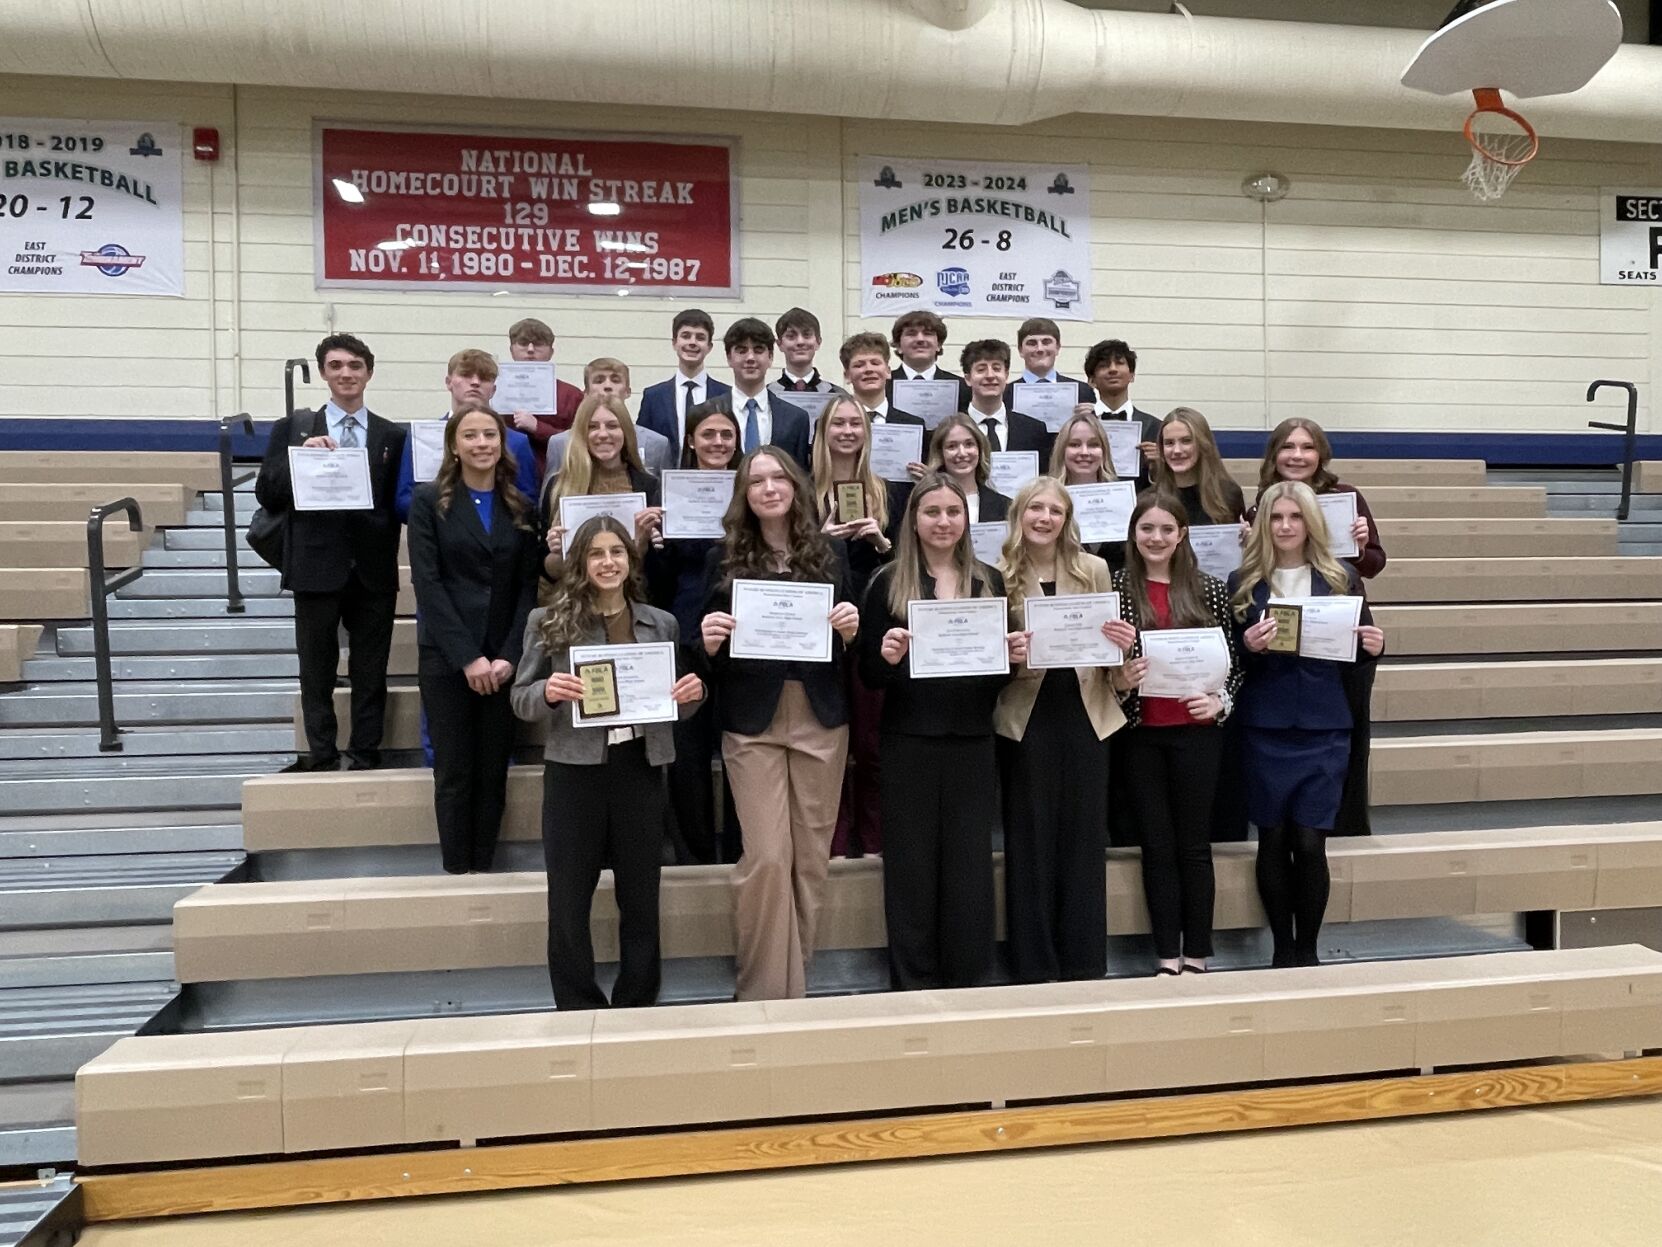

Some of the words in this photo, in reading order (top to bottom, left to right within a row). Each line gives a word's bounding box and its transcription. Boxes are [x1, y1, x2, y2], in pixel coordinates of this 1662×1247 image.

[0, 134, 29, 150] 18
[51, 136, 104, 151] 2019
[461, 150, 592, 176] NATIONAL
[5, 160, 157, 205] BASKETBALL
[351, 170, 514, 198] HOMECOURT
[529, 177, 578, 200] WIN
[589, 179, 694, 204] STREAK
[924, 174, 967, 189] 2023
[984, 176, 1027, 191] 2024
[60, 196, 95, 219] 12
[504, 202, 549, 226] 129
[1626, 199, 1662, 219] SEC
[881, 200, 941, 232] MEN'S
[947, 198, 1070, 239] BASKETBALL
[25, 242, 46, 250] EAST
[396, 224, 580, 251] CONSECUTIVE
[593, 230, 659, 254] WINS
[942, 228, 974, 251] 26
[996, 230, 1012, 251] 8
[15, 254, 56, 263] DISTRICT
[349, 249, 408, 273] NOV.
[452, 252, 514, 276] 1980
[539, 255, 596, 278] DEC.
[602, 257, 636, 283] 12,
[642, 258, 701, 281] 1987
[8, 266, 63, 275] CHAMPIONS
[999, 272, 1017, 280] EAST
[1618, 270, 1657, 280] SEATS
[991, 283, 1025, 292] DISTRICT
[986, 294, 1030, 303] CHAMPIONS
